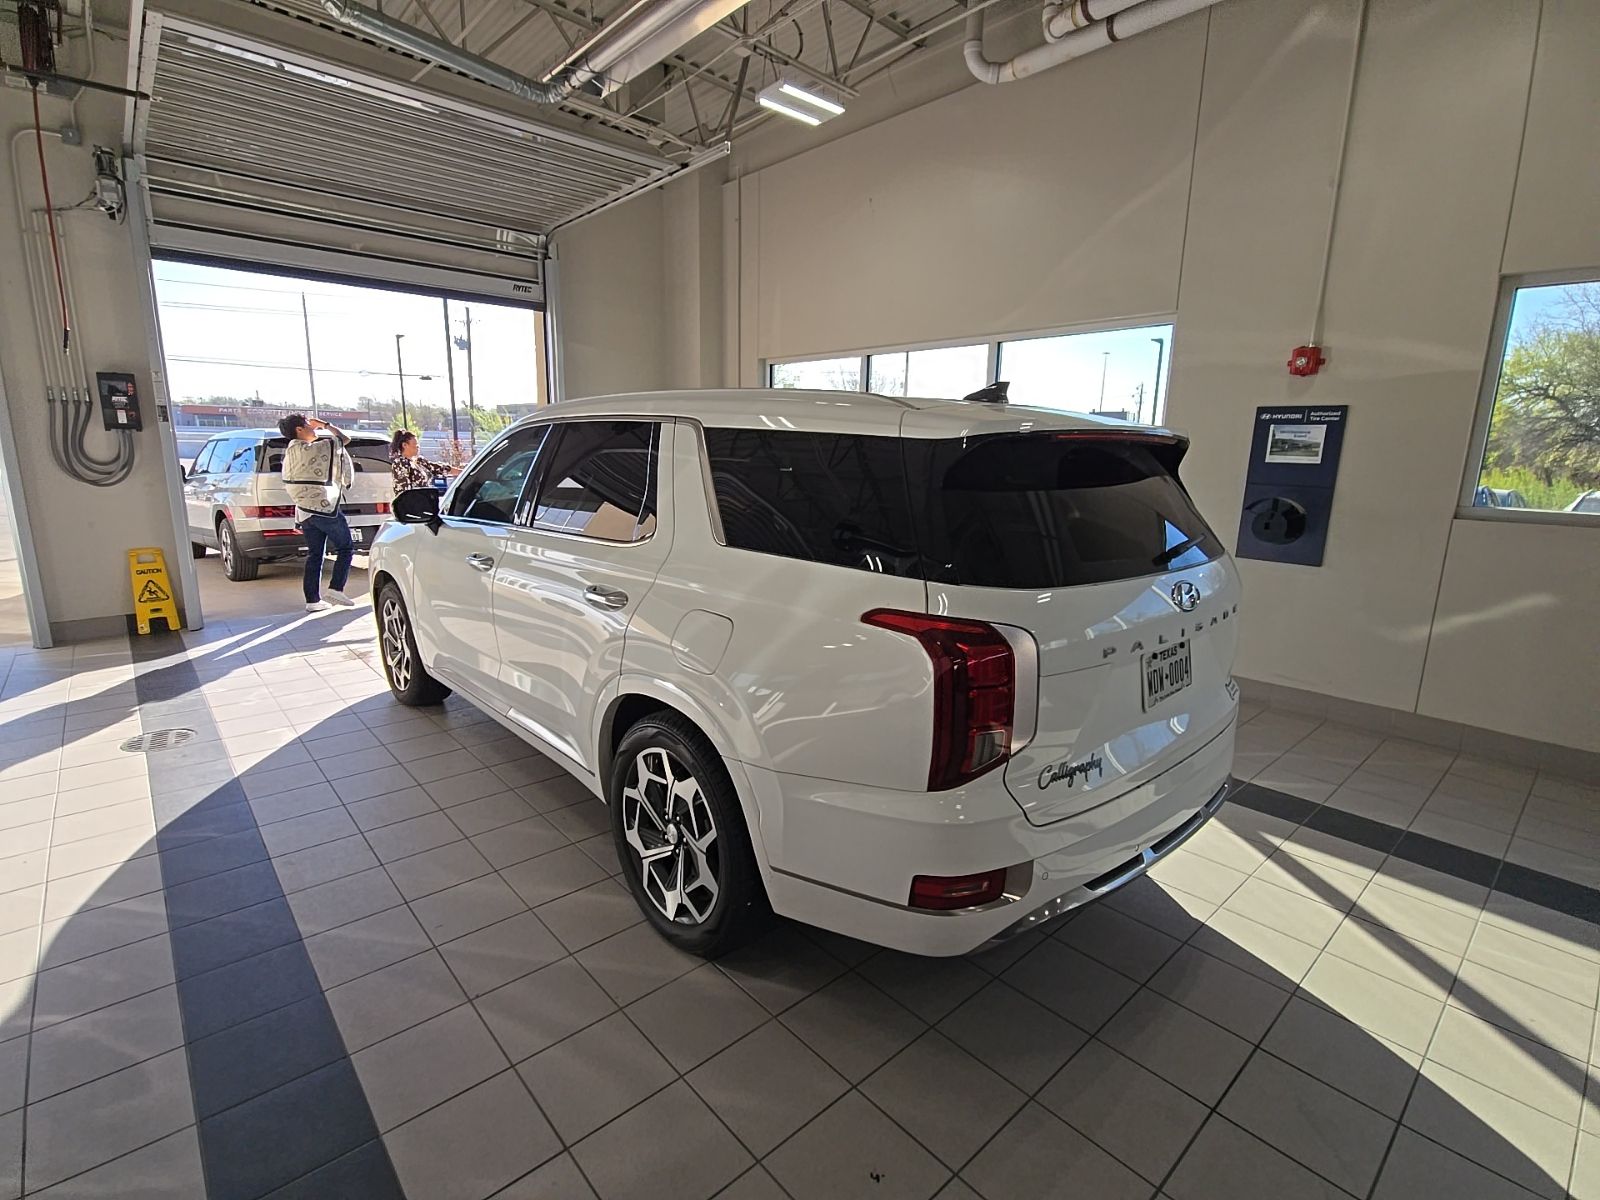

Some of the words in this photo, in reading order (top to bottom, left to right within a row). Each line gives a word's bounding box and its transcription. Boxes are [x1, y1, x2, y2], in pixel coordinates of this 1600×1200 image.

[512, 284, 533, 293] RYTEC
[218, 407, 242, 416] PARTS
[1102, 603, 1237, 659] PALISADE
[1159, 645, 1178, 661] TEXAS
[1037, 752, 1102, 790] Calligraphy
